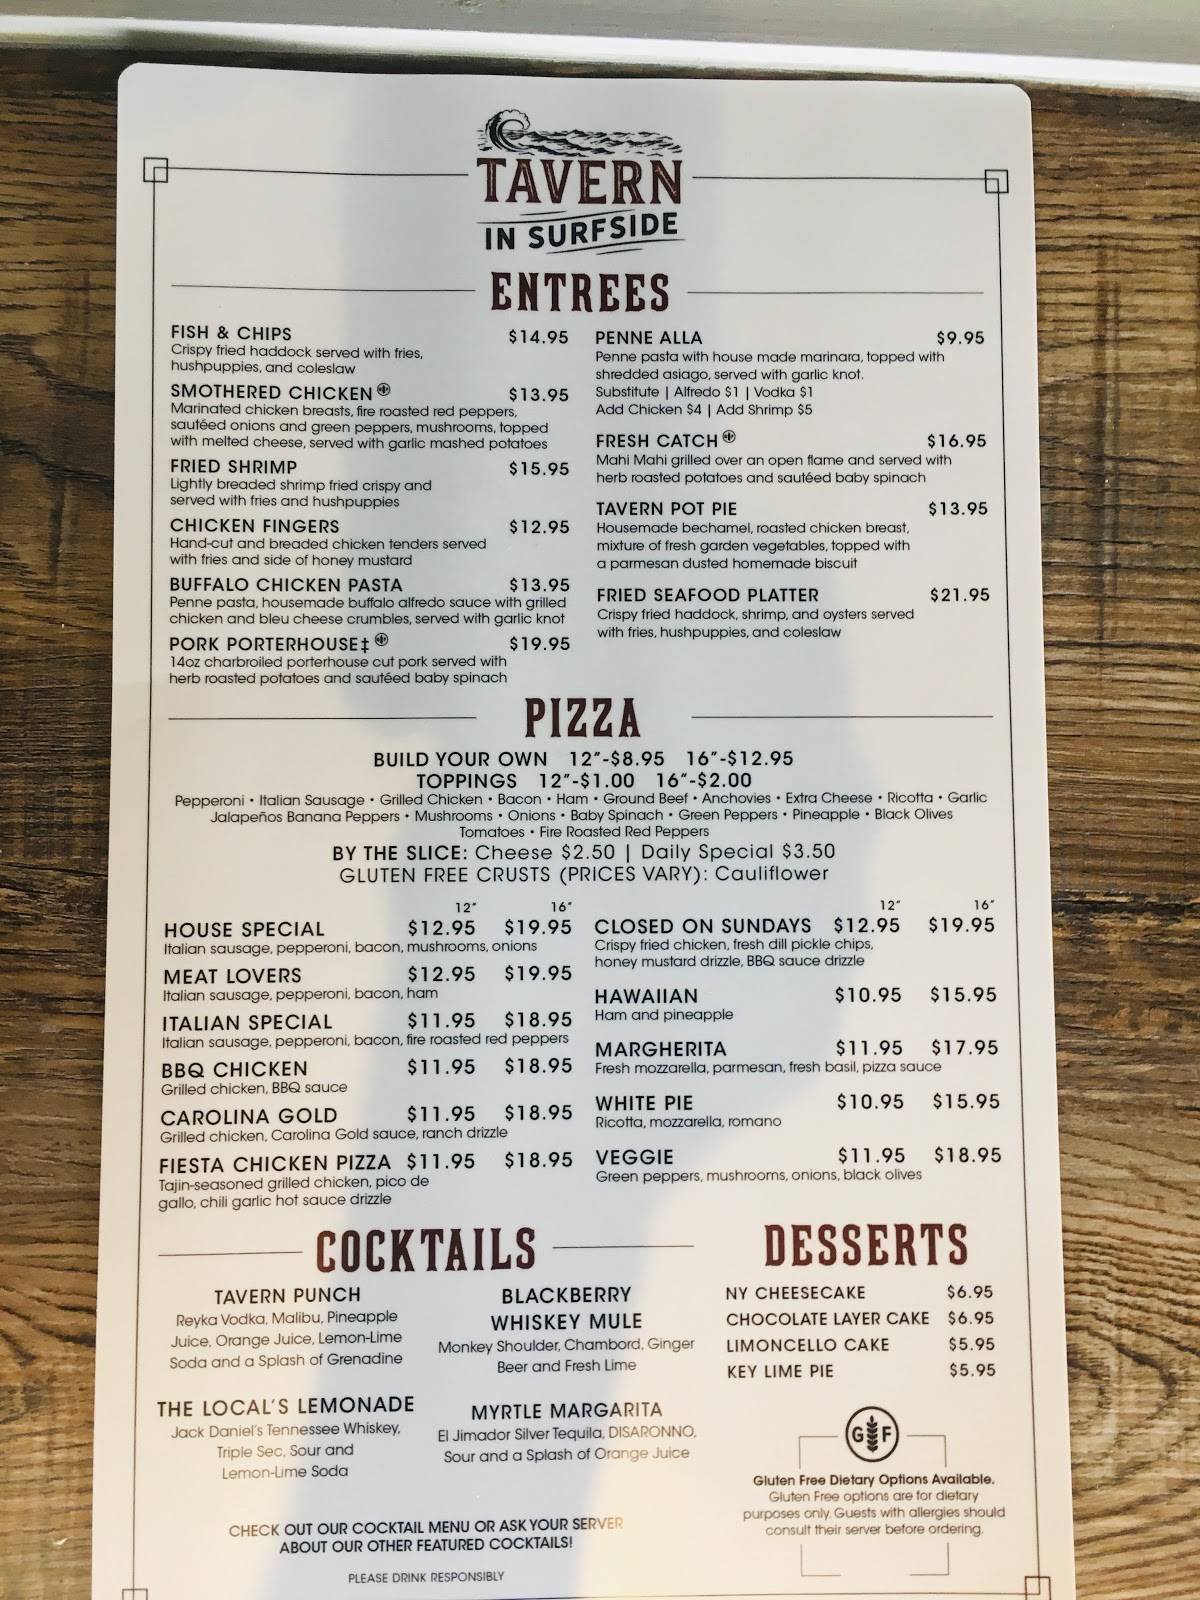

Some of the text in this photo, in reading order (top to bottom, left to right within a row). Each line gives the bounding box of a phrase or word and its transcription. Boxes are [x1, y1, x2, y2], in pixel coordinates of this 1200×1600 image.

[477, 157, 683, 205] TAVERN
[485, 212, 678, 251] IN SURFSIDE
[491, 271, 670, 313] ENTREES
[170, 324, 292, 341] FISH & CHIPS
[508, 328, 569, 345] $14.95
[594, 330, 703, 345] PENNE ALLA
[936, 330, 985, 346] $9.95
[170, 343, 423, 360] Crispy fried haddock served with fries,
[594, 350, 945, 365] Penne pasta with house made marinara, topped with
[170, 383, 374, 401] SMOTHERED CHICKEN
[508, 386, 569, 403] $13.95
[595, 433, 720, 448] FRESH CATCH
[926, 433, 987, 449] $16.95
[170, 458, 297, 475] FRIED SHRIMP
[508, 460, 570, 477] $15.95
[595, 501, 737, 516] TAVERN POT PIE
[927, 501, 988, 517] $13.95
[169, 518, 340, 534] CHICKEN FINGERS
[508, 519, 570, 535] $12.95
[596, 521, 910, 535] Housemade bechamel, roasted chicken breast,
[169, 536, 487, 550] Hand-cut and breaded chicken tenders served
[596, 587, 819, 603] FRIED SEAFOOD PLATTER
[929, 587, 990, 603] $21.95
[525, 697, 641, 739] PIZZA
[373, 751, 547, 768] BUILD YOUR OWN
[209, 807, 953, 825] Jalapeños Banana Peppers Mushrooms Onions Baby Spinach Green Peppers Pineapple Black Olives
[338, 865, 829, 887] GLUTEN FREE CRUSTS (PRICES VARY): Cauliflower
[163, 921, 325, 938] HOUSE SPECIAL
[407, 919, 476, 937] $12.95
[504, 918, 572, 936] $19.95
[593, 917, 812, 935] CLOSED ON SUNDAYS
[833, 916, 900, 934] $12.95
[928, 916, 995, 934] $19.95
[594, 988, 698, 1005] HAWAIIAN
[834, 986, 902, 1004] $10.95
[929, 985, 997, 1003] $15.95
[594, 1008, 734, 1023] Ham and pineapple
[594, 1095, 693, 1112] WHITE PIE
[836, 1092, 904, 1111] $10.95
[932, 1092, 1000, 1110] $15.95
[159, 1107, 338, 1127] CAROLINA GOLD
[406, 1105, 475, 1123] $11.95
[504, 1103, 573, 1122] $18.95
[594, 1115, 782, 1129] Ricotta, mozzarella, romano
[157, 1192, 392, 1213] gallo, chili garlic hot sauce drizzle
[317, 1227, 536, 1273] COCKTAILS
[765, 1223, 969, 1267] DESSERTS
[213, 1286, 361, 1305] TAVERN PUNCH
[501, 1286, 632, 1305] BLACKBERRY
[725, 1285, 865, 1301] NY CHEESECAKE
[946, 1284, 993, 1300] $6.95
[489, 1312, 642, 1332] WHISKEY MULE
[725, 1311, 930, 1327] CHOCOLATE LAYER CAKE
[947, 1310, 994, 1326] $6.95
[437, 1337, 694, 1355] Monkey Shoulder, Chambord, Ginger
[169, 1352, 403, 1369] Soda and a Splash of Grenadine
[156, 1401, 193, 1417] THE
[297, 1395, 414, 1414] LEMONADE
[470, 1401, 663, 1421] MYRTLE MARGARITA
[752, 1473, 995, 1488] Gluten Free Dietary Options Available.
[764, 1523, 984, 1538] consult their server before ordering.
[347, 1571, 505, 1584] PLEASE DRINK RESPONSIBLY
